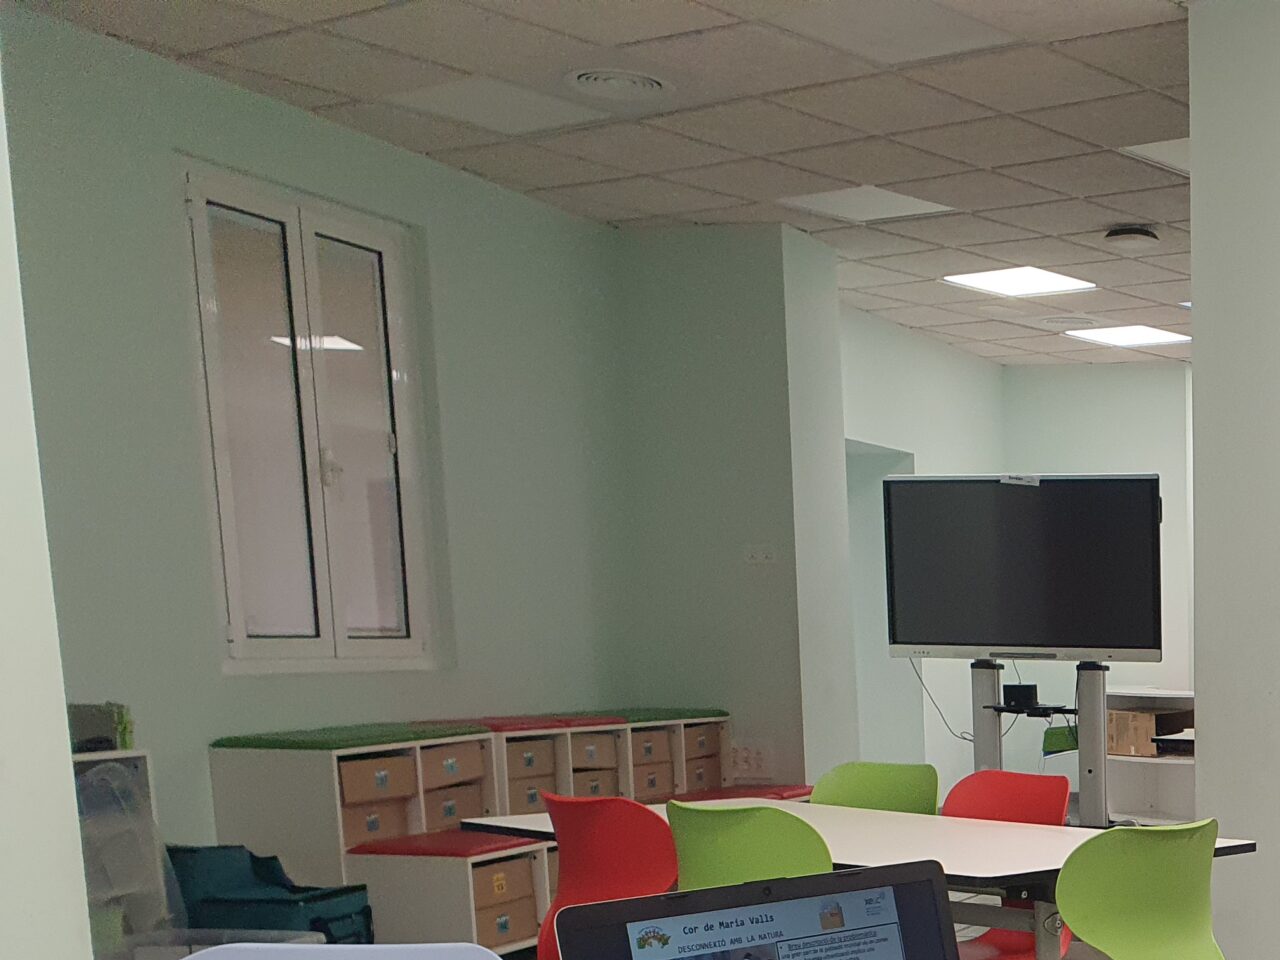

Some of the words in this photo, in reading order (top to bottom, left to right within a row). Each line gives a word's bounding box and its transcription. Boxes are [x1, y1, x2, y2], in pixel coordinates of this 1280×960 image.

[682, 925, 699, 936] Cor
[704, 921, 714, 932] de
[749, 913, 775, 926] Valls
[730, 936, 743, 947] AMB
[746, 935, 756, 944] LA
[758, 930, 785, 942] NATURA
